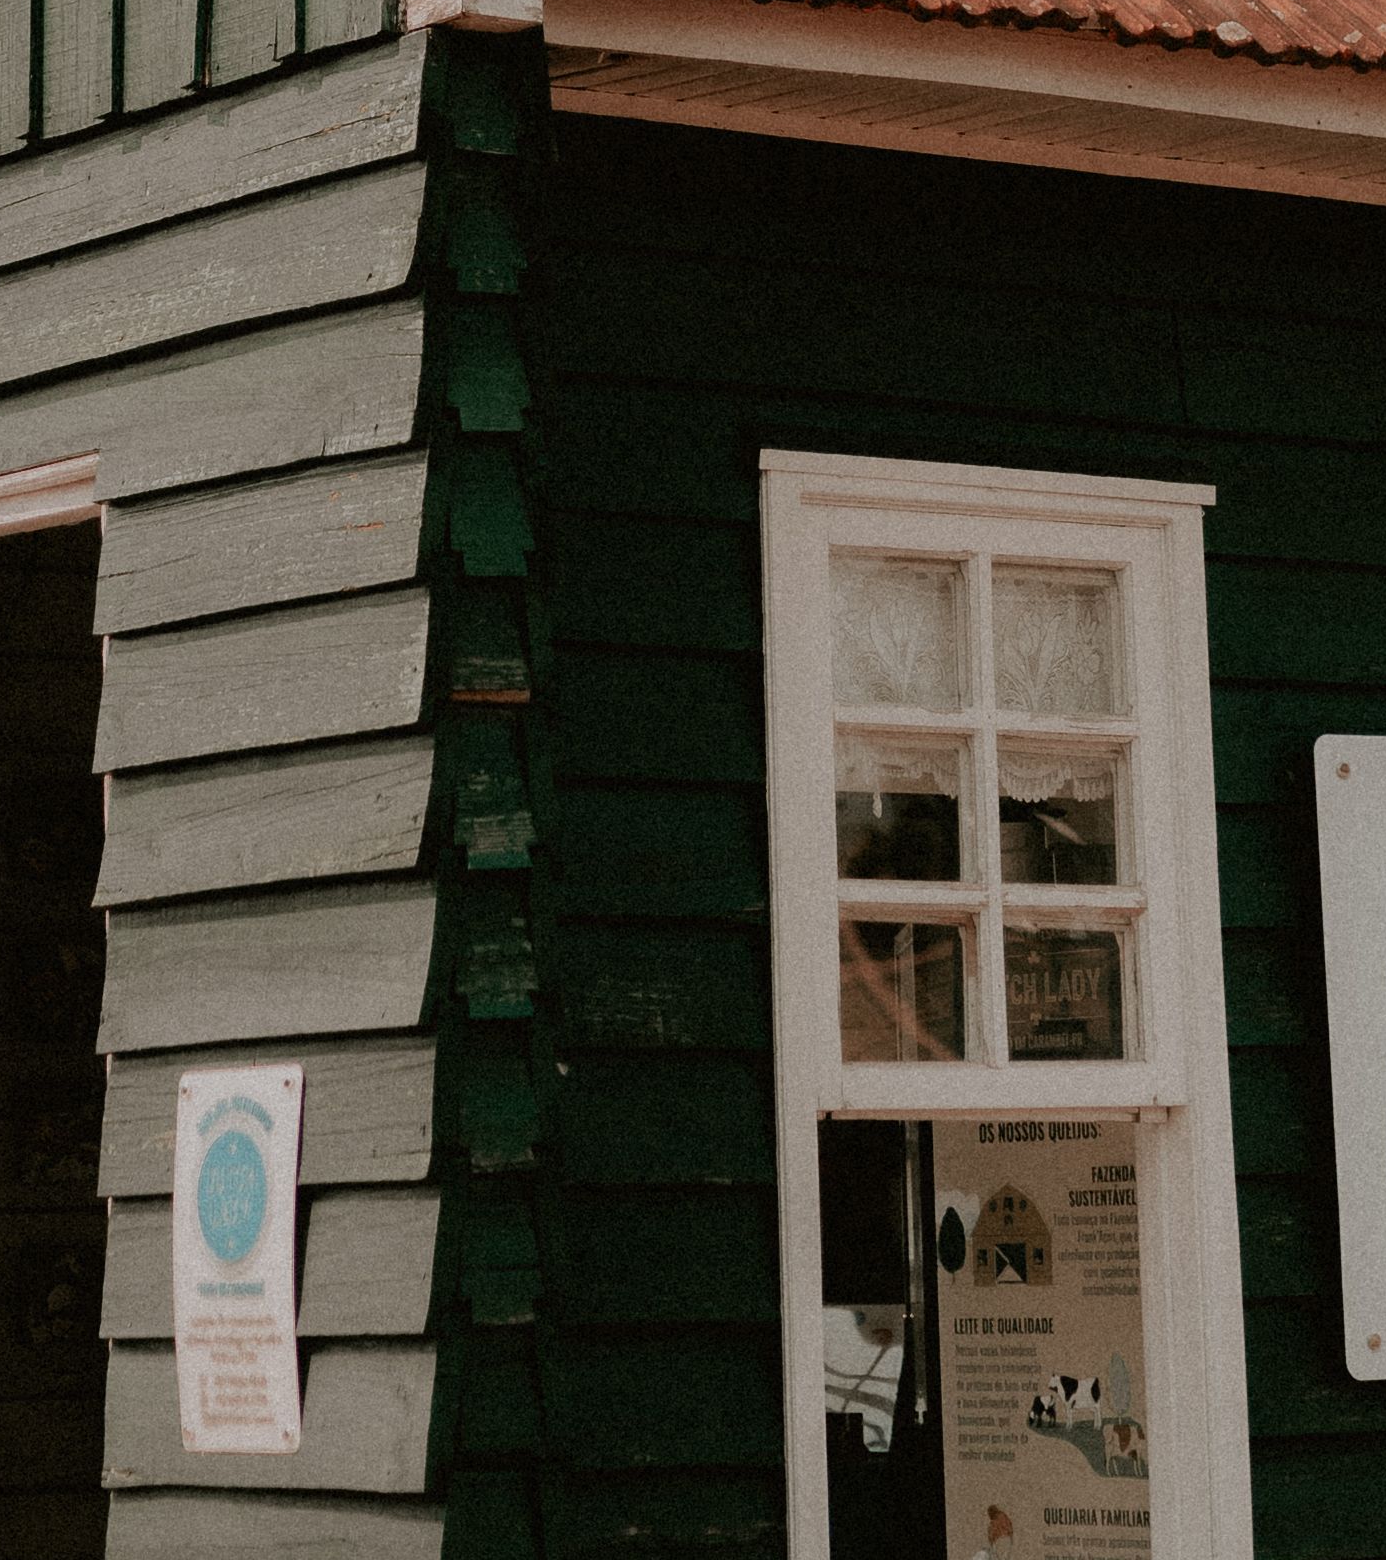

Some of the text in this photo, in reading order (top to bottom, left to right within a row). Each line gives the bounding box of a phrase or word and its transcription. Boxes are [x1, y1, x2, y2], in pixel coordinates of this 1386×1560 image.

[979, 1122, 994, 1144] OS
[997, 1121, 1045, 1142] NOSSOS
[1091, 1164, 1136, 1183] FAZENDA
[1069, 1185, 1137, 1207] SUSTENTÁVEL
[954, 1317, 1055, 1337] LEITE DE QUALIDADE
[1044, 1507, 1151, 1527] QUEIJARIA FAMILIAR
